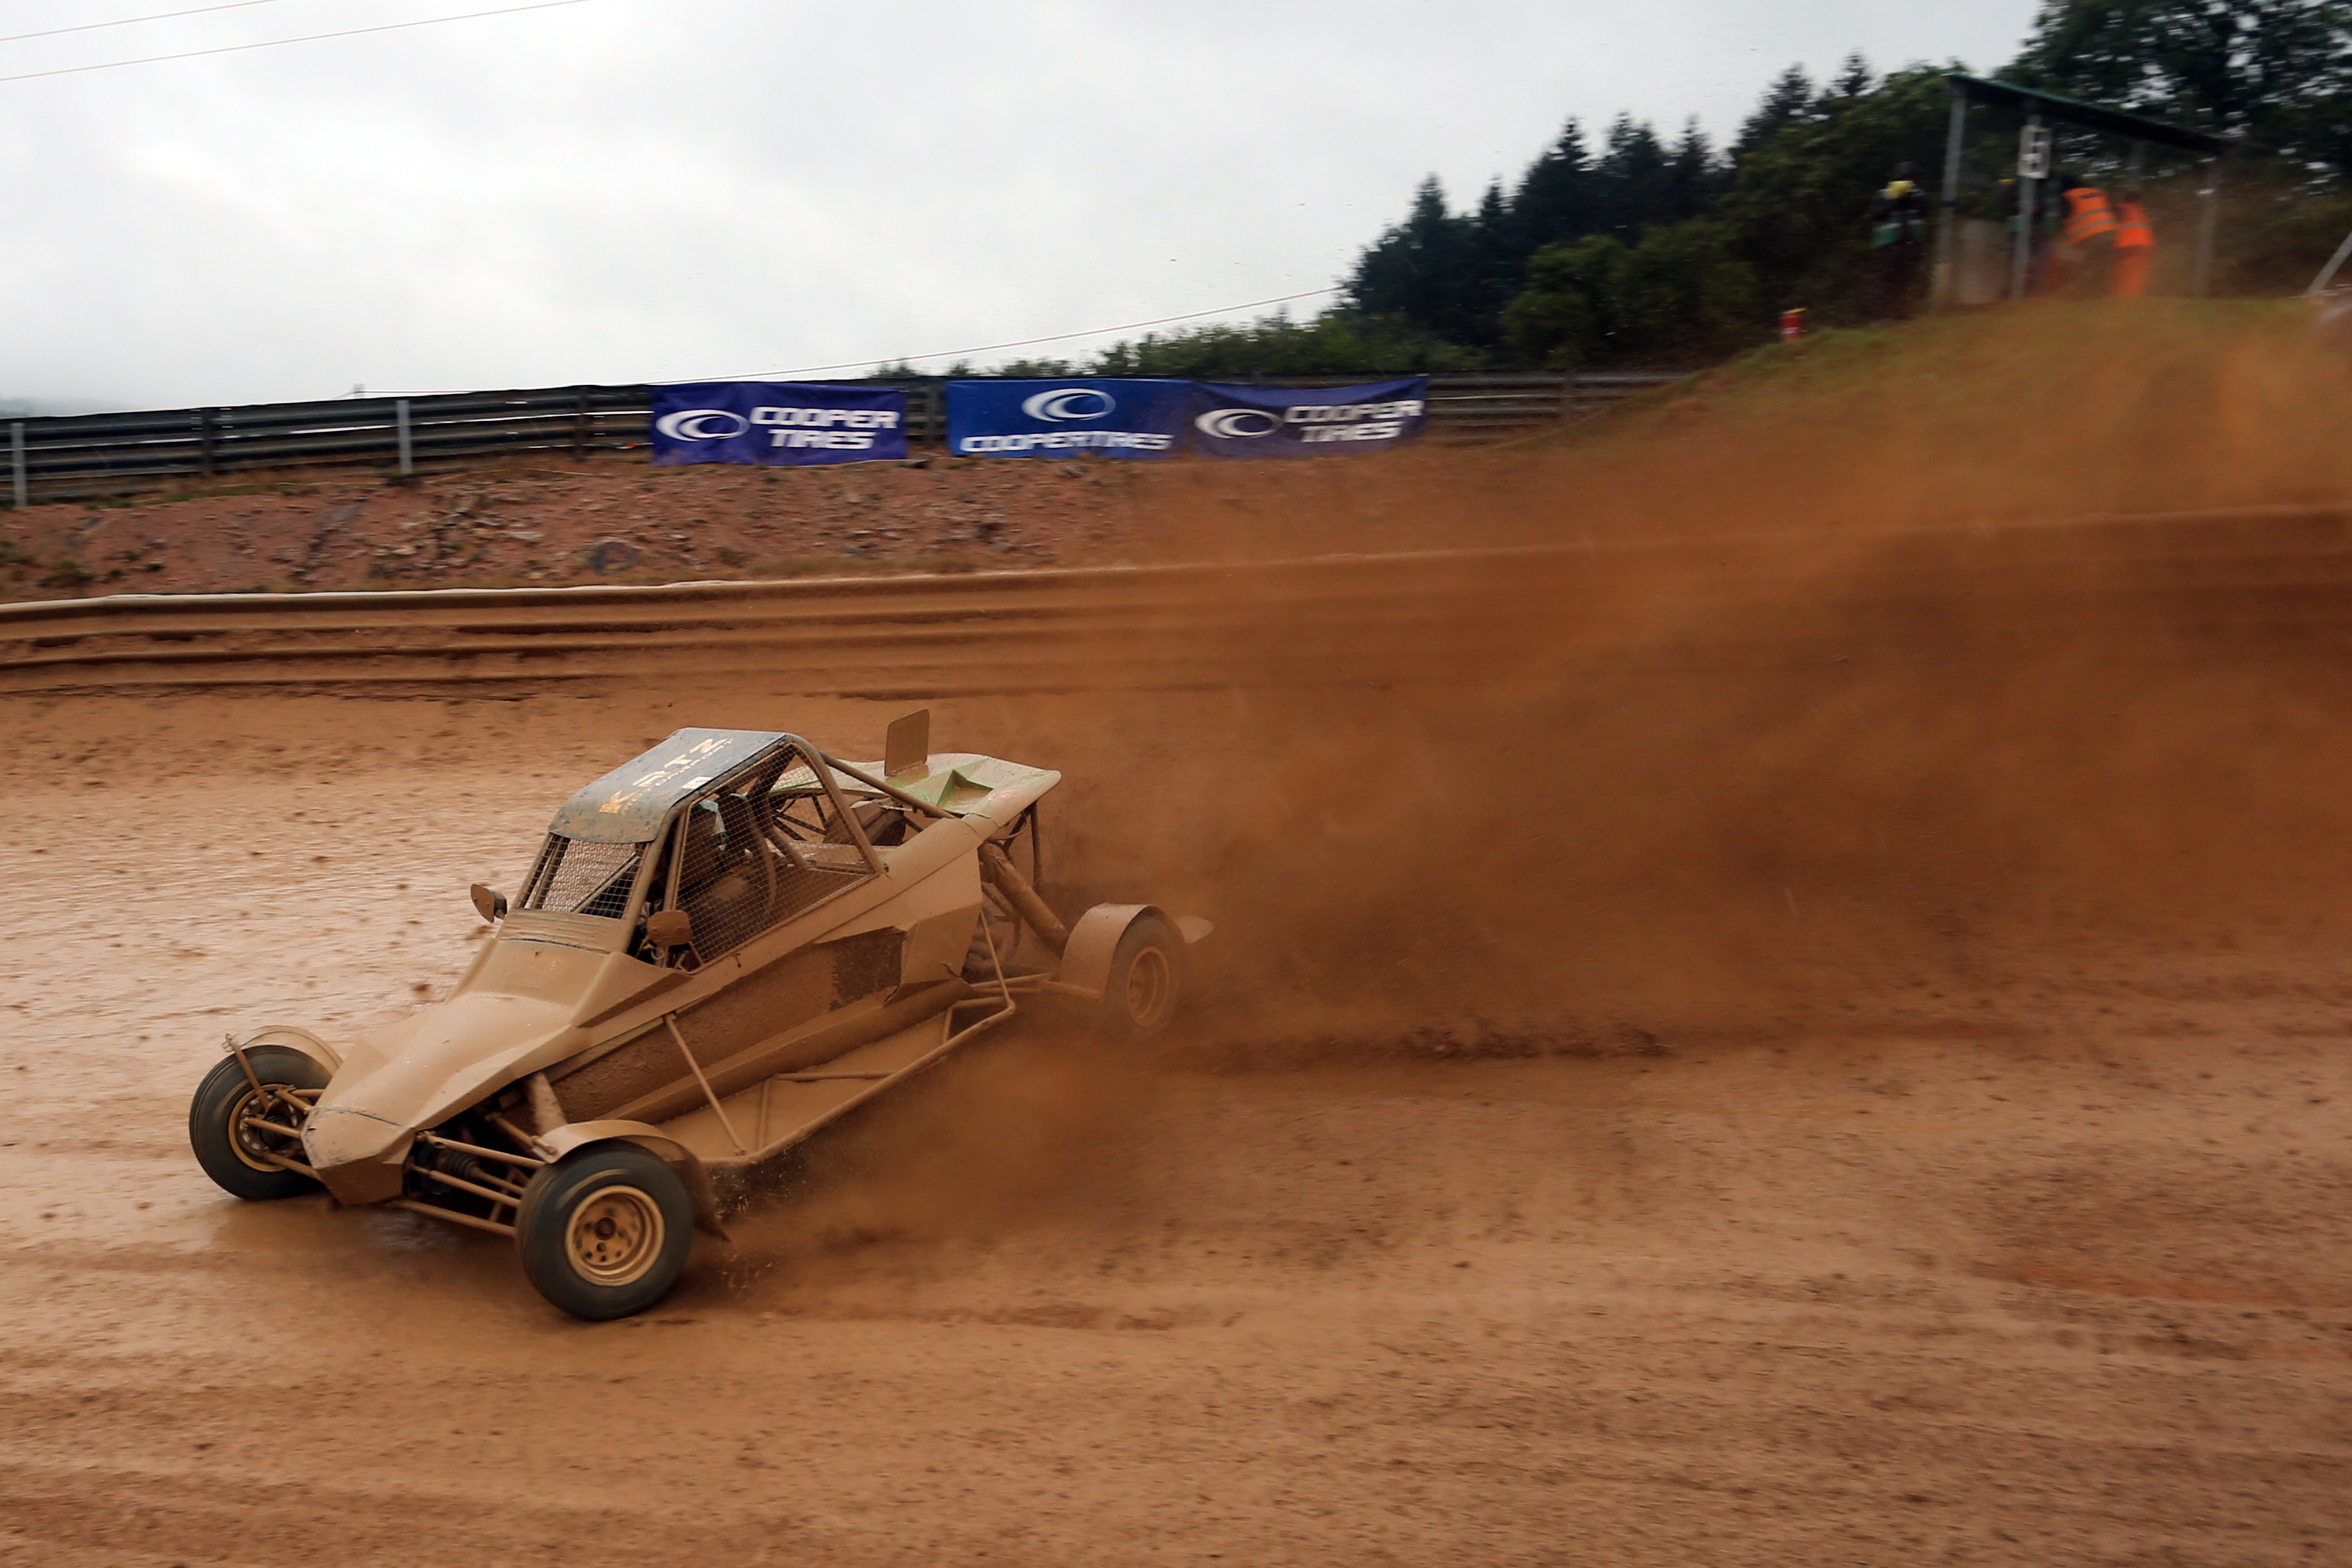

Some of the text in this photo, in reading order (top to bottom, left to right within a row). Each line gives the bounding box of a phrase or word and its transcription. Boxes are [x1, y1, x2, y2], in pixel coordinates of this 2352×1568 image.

[749, 406, 901, 429] COOPER
[1284, 400, 1424, 423] COOPER
[768, 428, 877, 449] TIRES
[1300, 421, 1407, 442] TIRES
